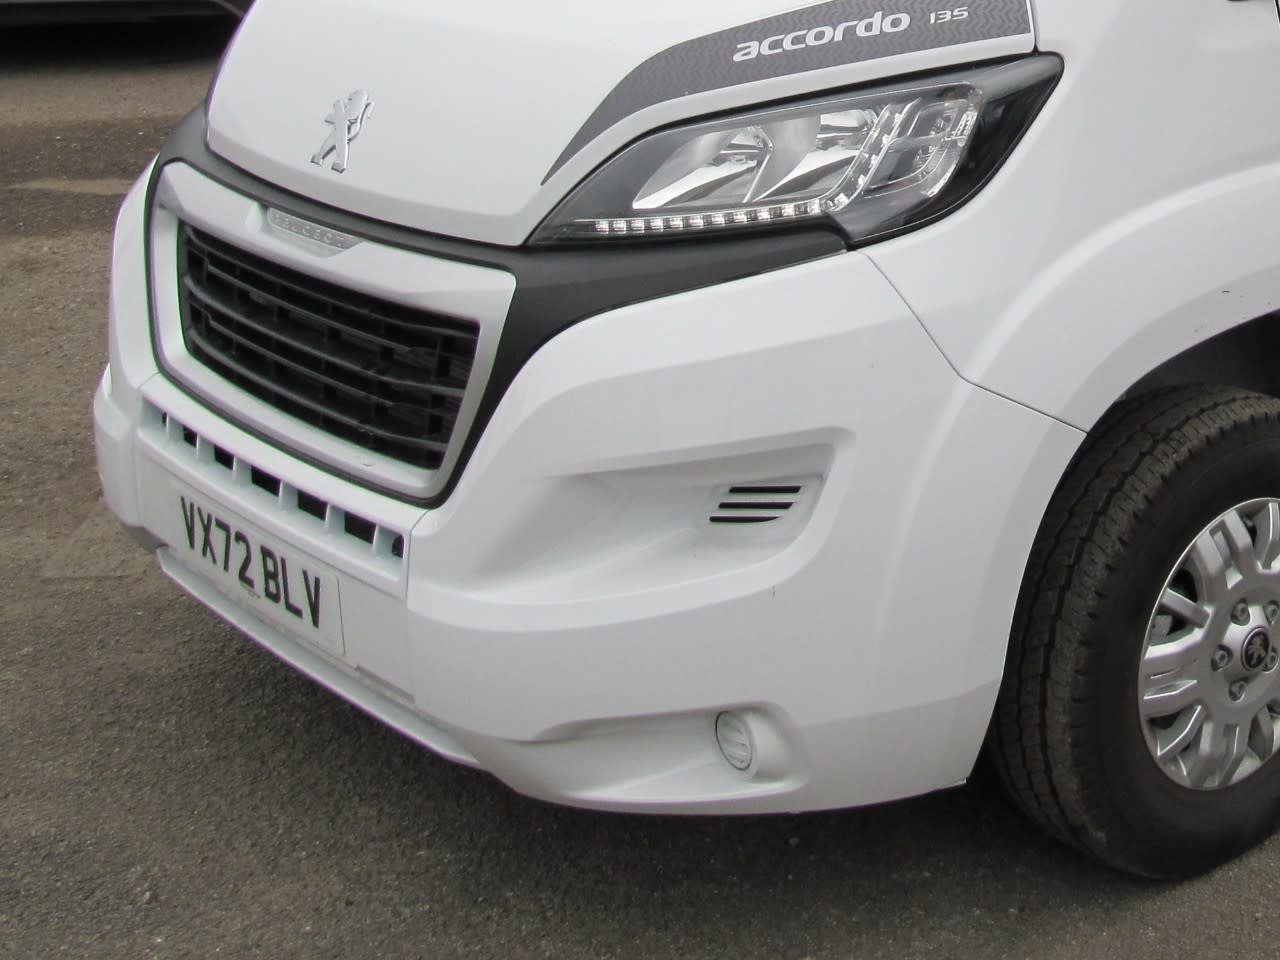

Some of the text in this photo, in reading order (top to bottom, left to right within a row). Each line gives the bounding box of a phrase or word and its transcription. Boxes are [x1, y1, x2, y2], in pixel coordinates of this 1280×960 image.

[733, 10, 911, 62] accordo
[180, 495, 321, 629] VX72 BLV
